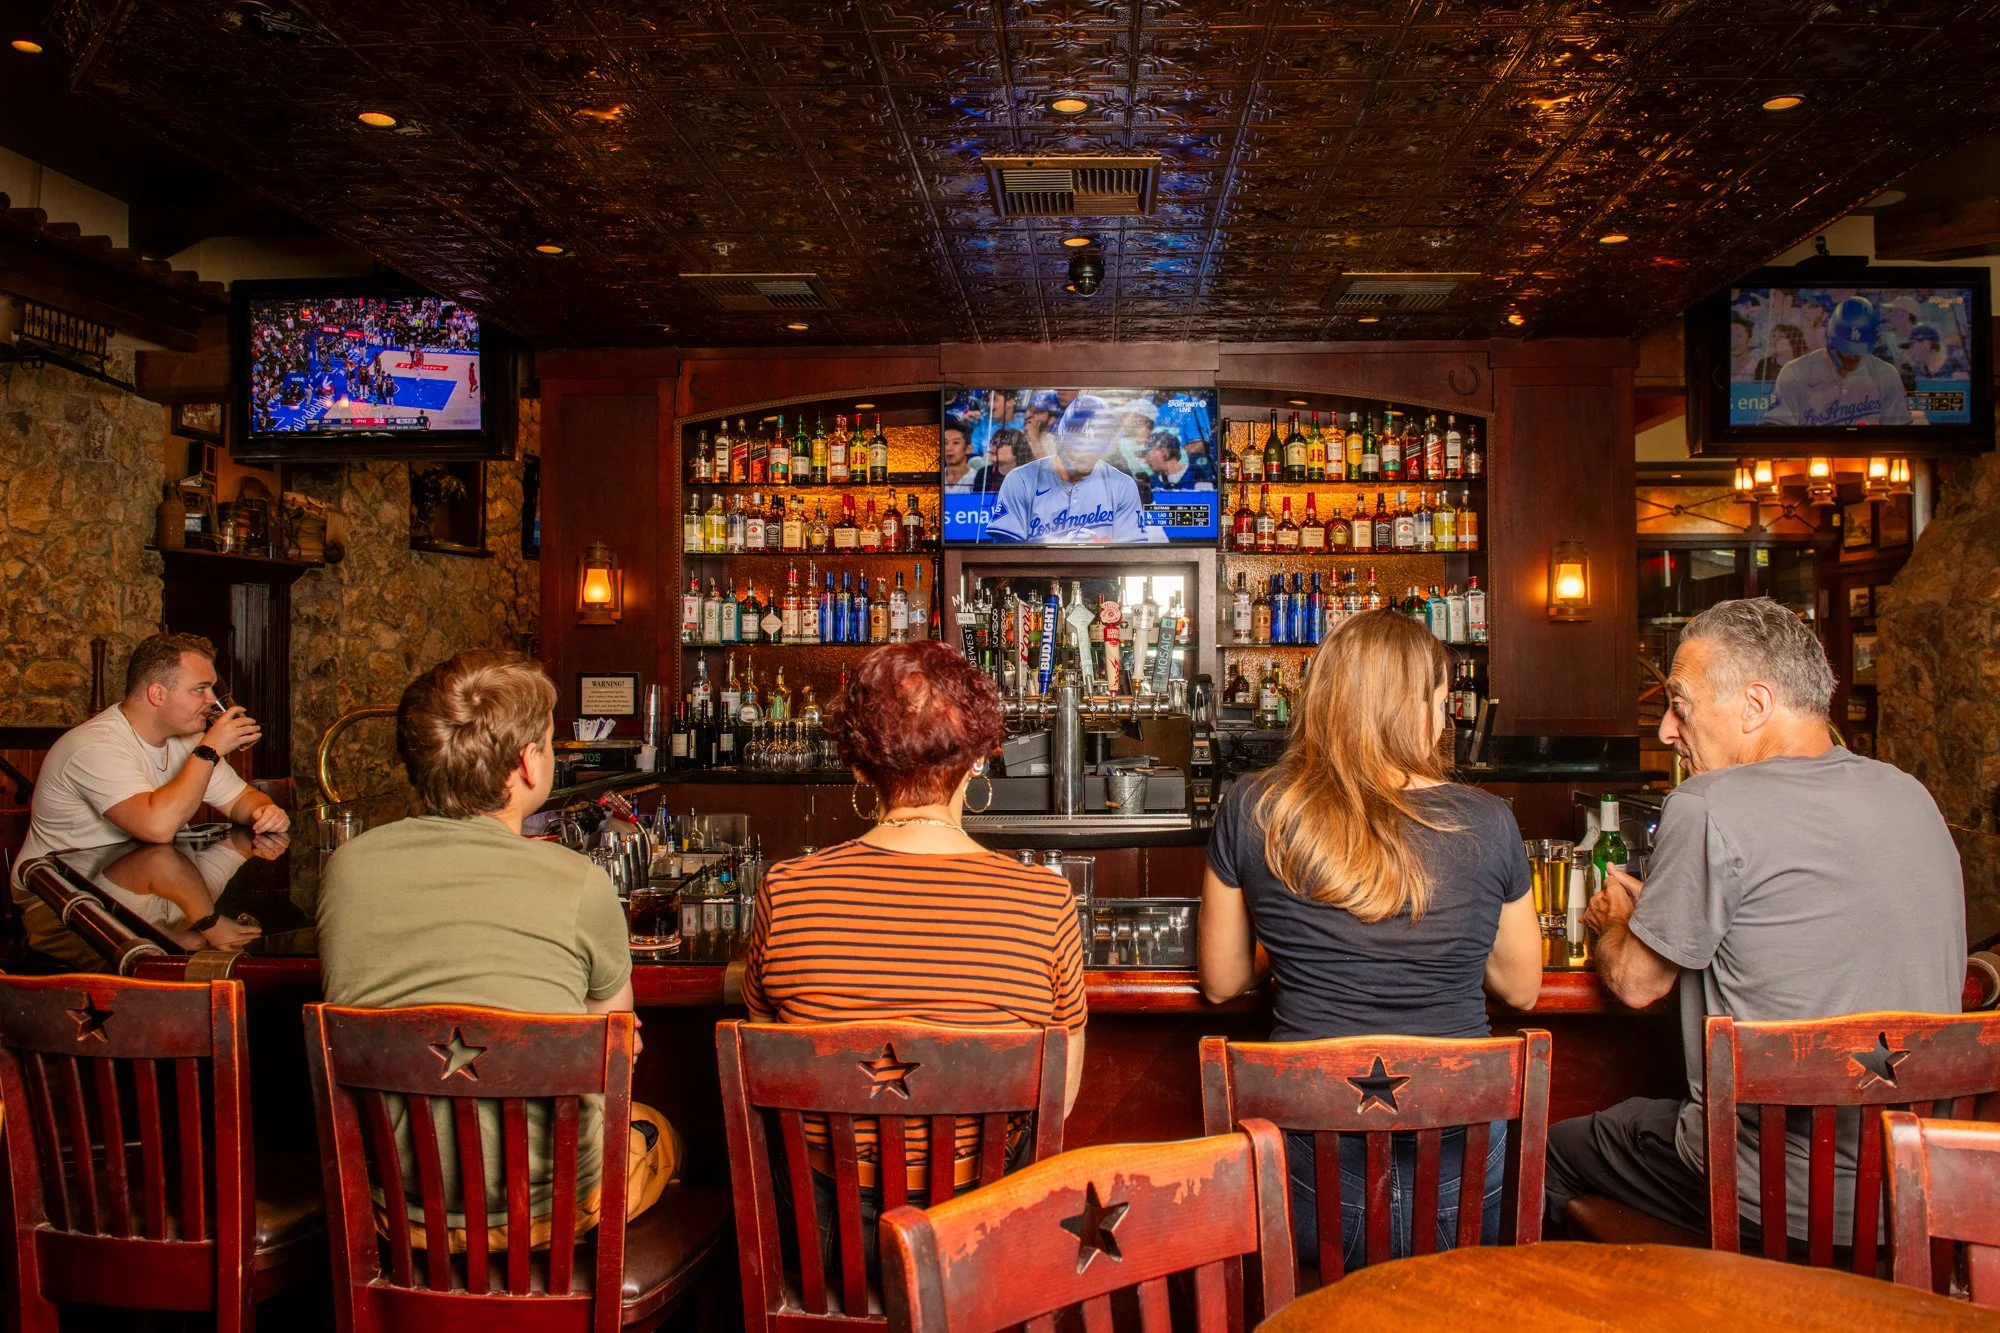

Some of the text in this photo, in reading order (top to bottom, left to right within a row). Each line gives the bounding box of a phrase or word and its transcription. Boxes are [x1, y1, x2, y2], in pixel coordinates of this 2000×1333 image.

[955, 510, 989, 524] ena
[1028, 504, 1113, 539] Los Angeles
[965, 628, 977, 669] DEWEST
[1020, 604, 1031, 662] Coors
[1041, 606, 1055, 671] BUD LIGHT
[1157, 633, 1172, 676] MOSAIC
